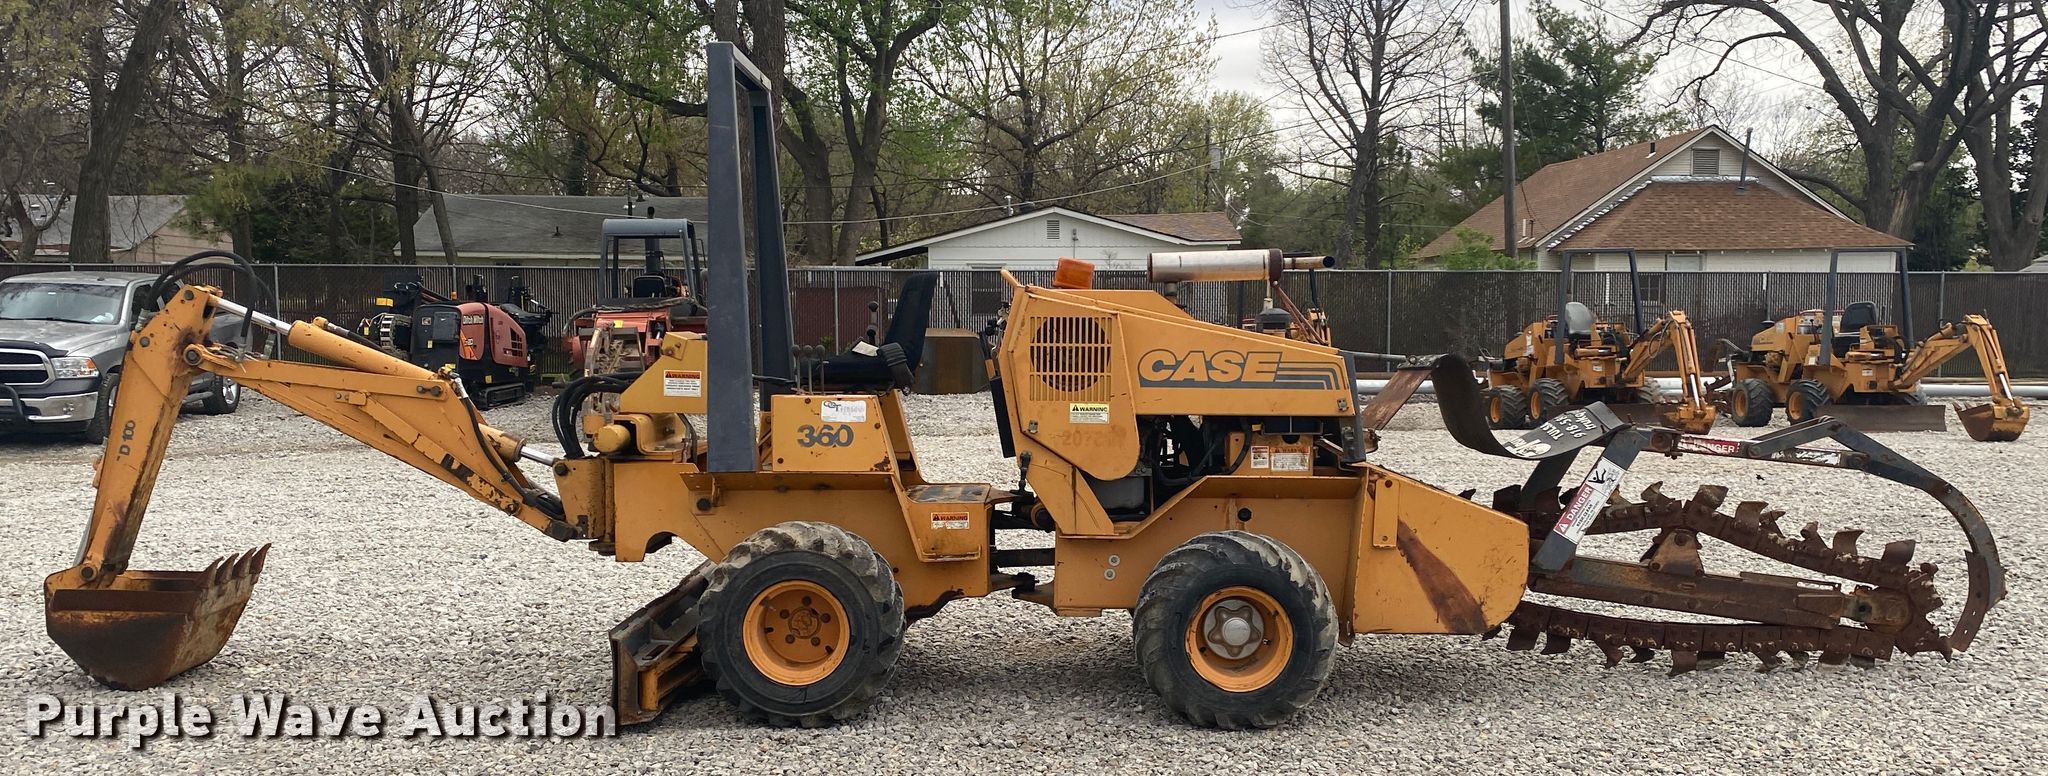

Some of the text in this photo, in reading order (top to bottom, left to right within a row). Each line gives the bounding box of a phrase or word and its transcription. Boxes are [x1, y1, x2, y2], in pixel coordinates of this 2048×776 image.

[1138, 349, 1282, 382] CASE
[797, 424, 854, 447] 360
[1566, 486, 1593, 521] DANGER
